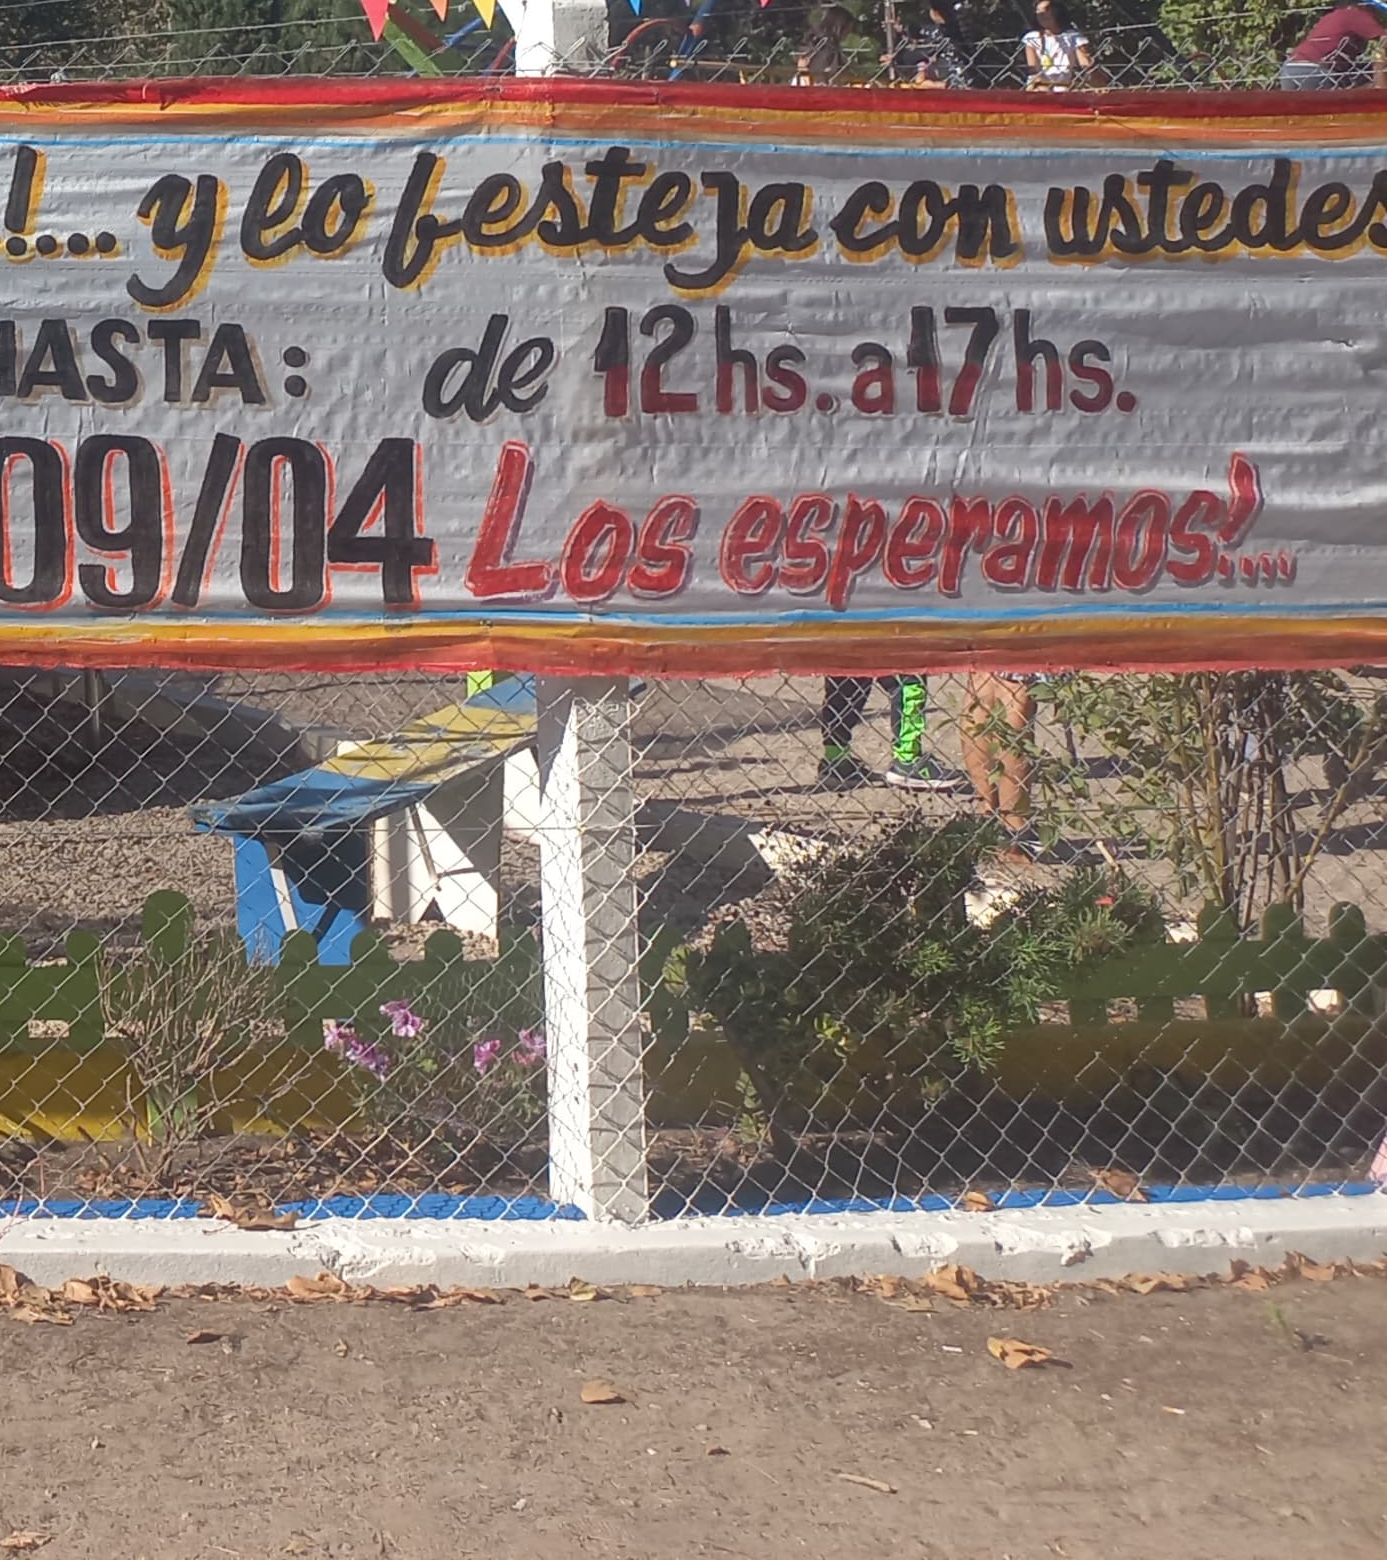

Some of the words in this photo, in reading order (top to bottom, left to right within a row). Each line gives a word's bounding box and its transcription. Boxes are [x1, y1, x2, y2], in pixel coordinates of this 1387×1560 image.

[127, 174, 227, 313] y
[239, 152, 378, 269] lo
[381, 146, 819, 300] festeja
[828, 178, 1021, 270] con
[421, 313, 559, 423] de
[465, 441, 701, 604] Los
